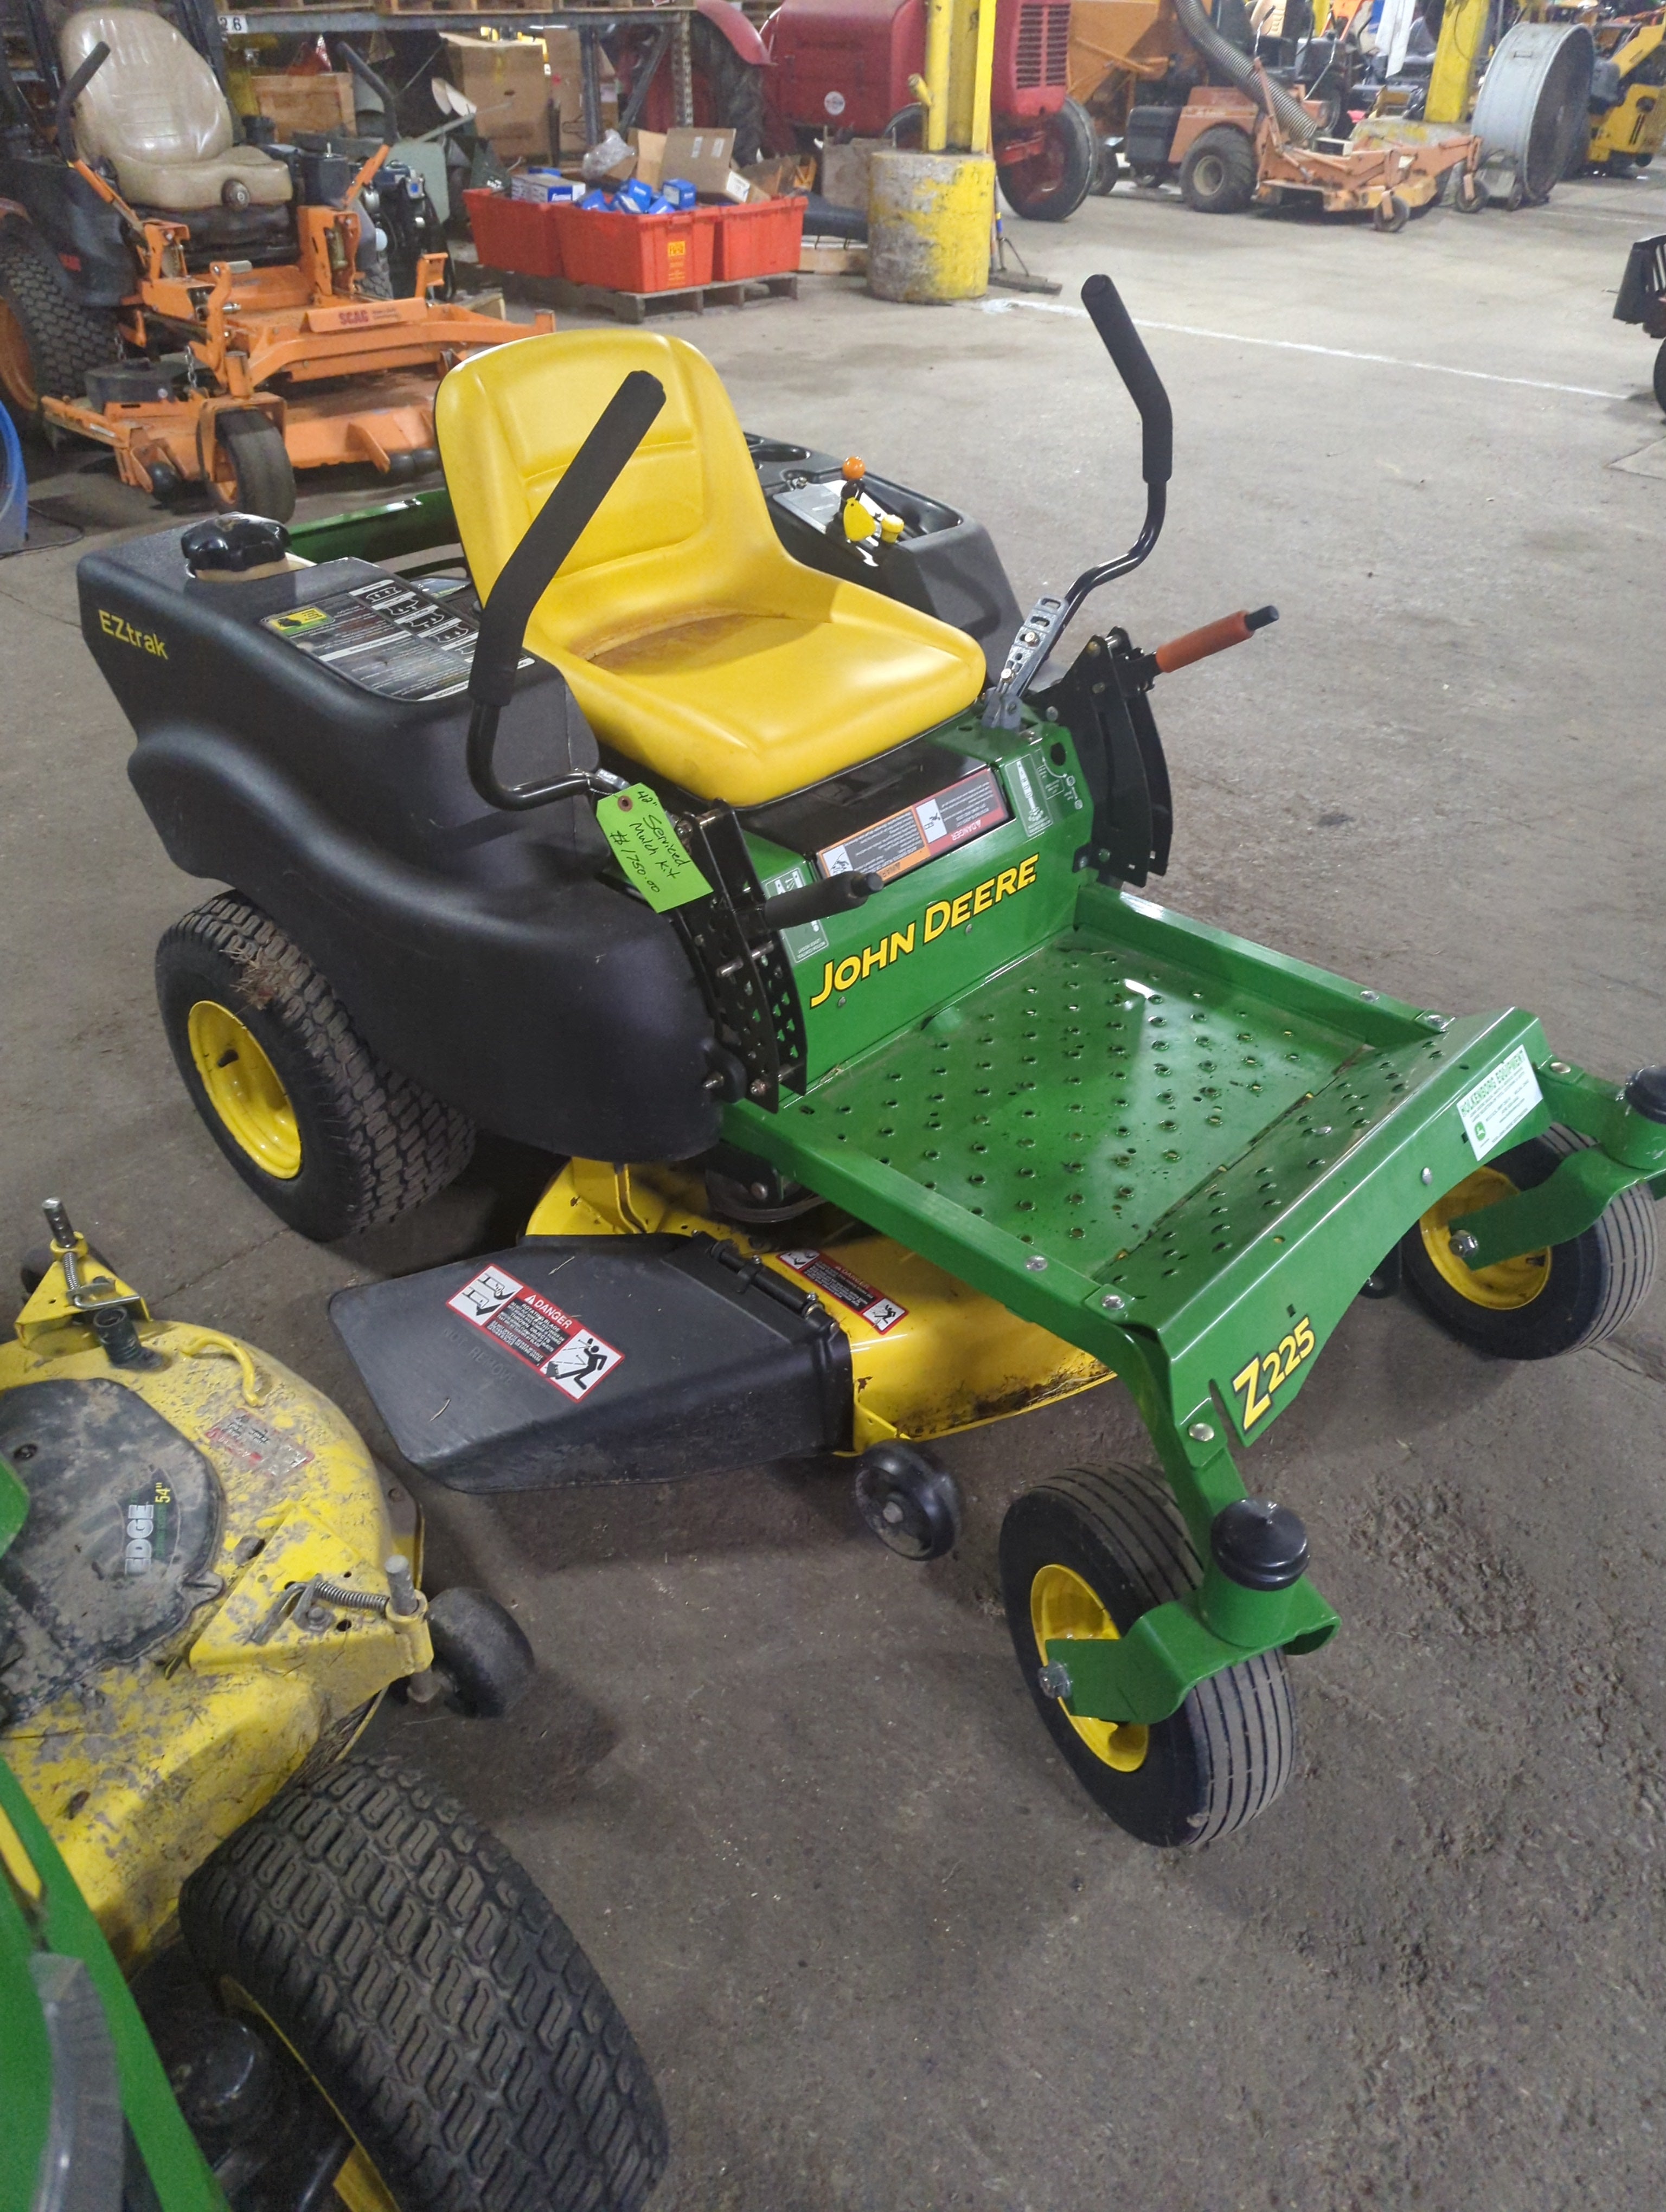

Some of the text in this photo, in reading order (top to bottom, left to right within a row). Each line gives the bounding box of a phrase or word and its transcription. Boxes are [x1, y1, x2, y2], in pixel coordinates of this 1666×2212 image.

[99, 609, 169, 660] EZtrak
[629, 822, 659, 856] Mulch
[643, 814, 691, 867] Serviced
[951, 822, 977, 841] DANGER
[810, 852, 1040, 1009] JOHN DEERE
[510, 1312, 530, 1328] THROWN
[521, 1303, 546, 1321] ROTATING
[534, 1299, 573, 1329] DANGER
[1232, 1314, 1316, 1432] Z225
[155, 1482, 171, 1503] 54"
[125, 1504, 155, 1575] EDGE
